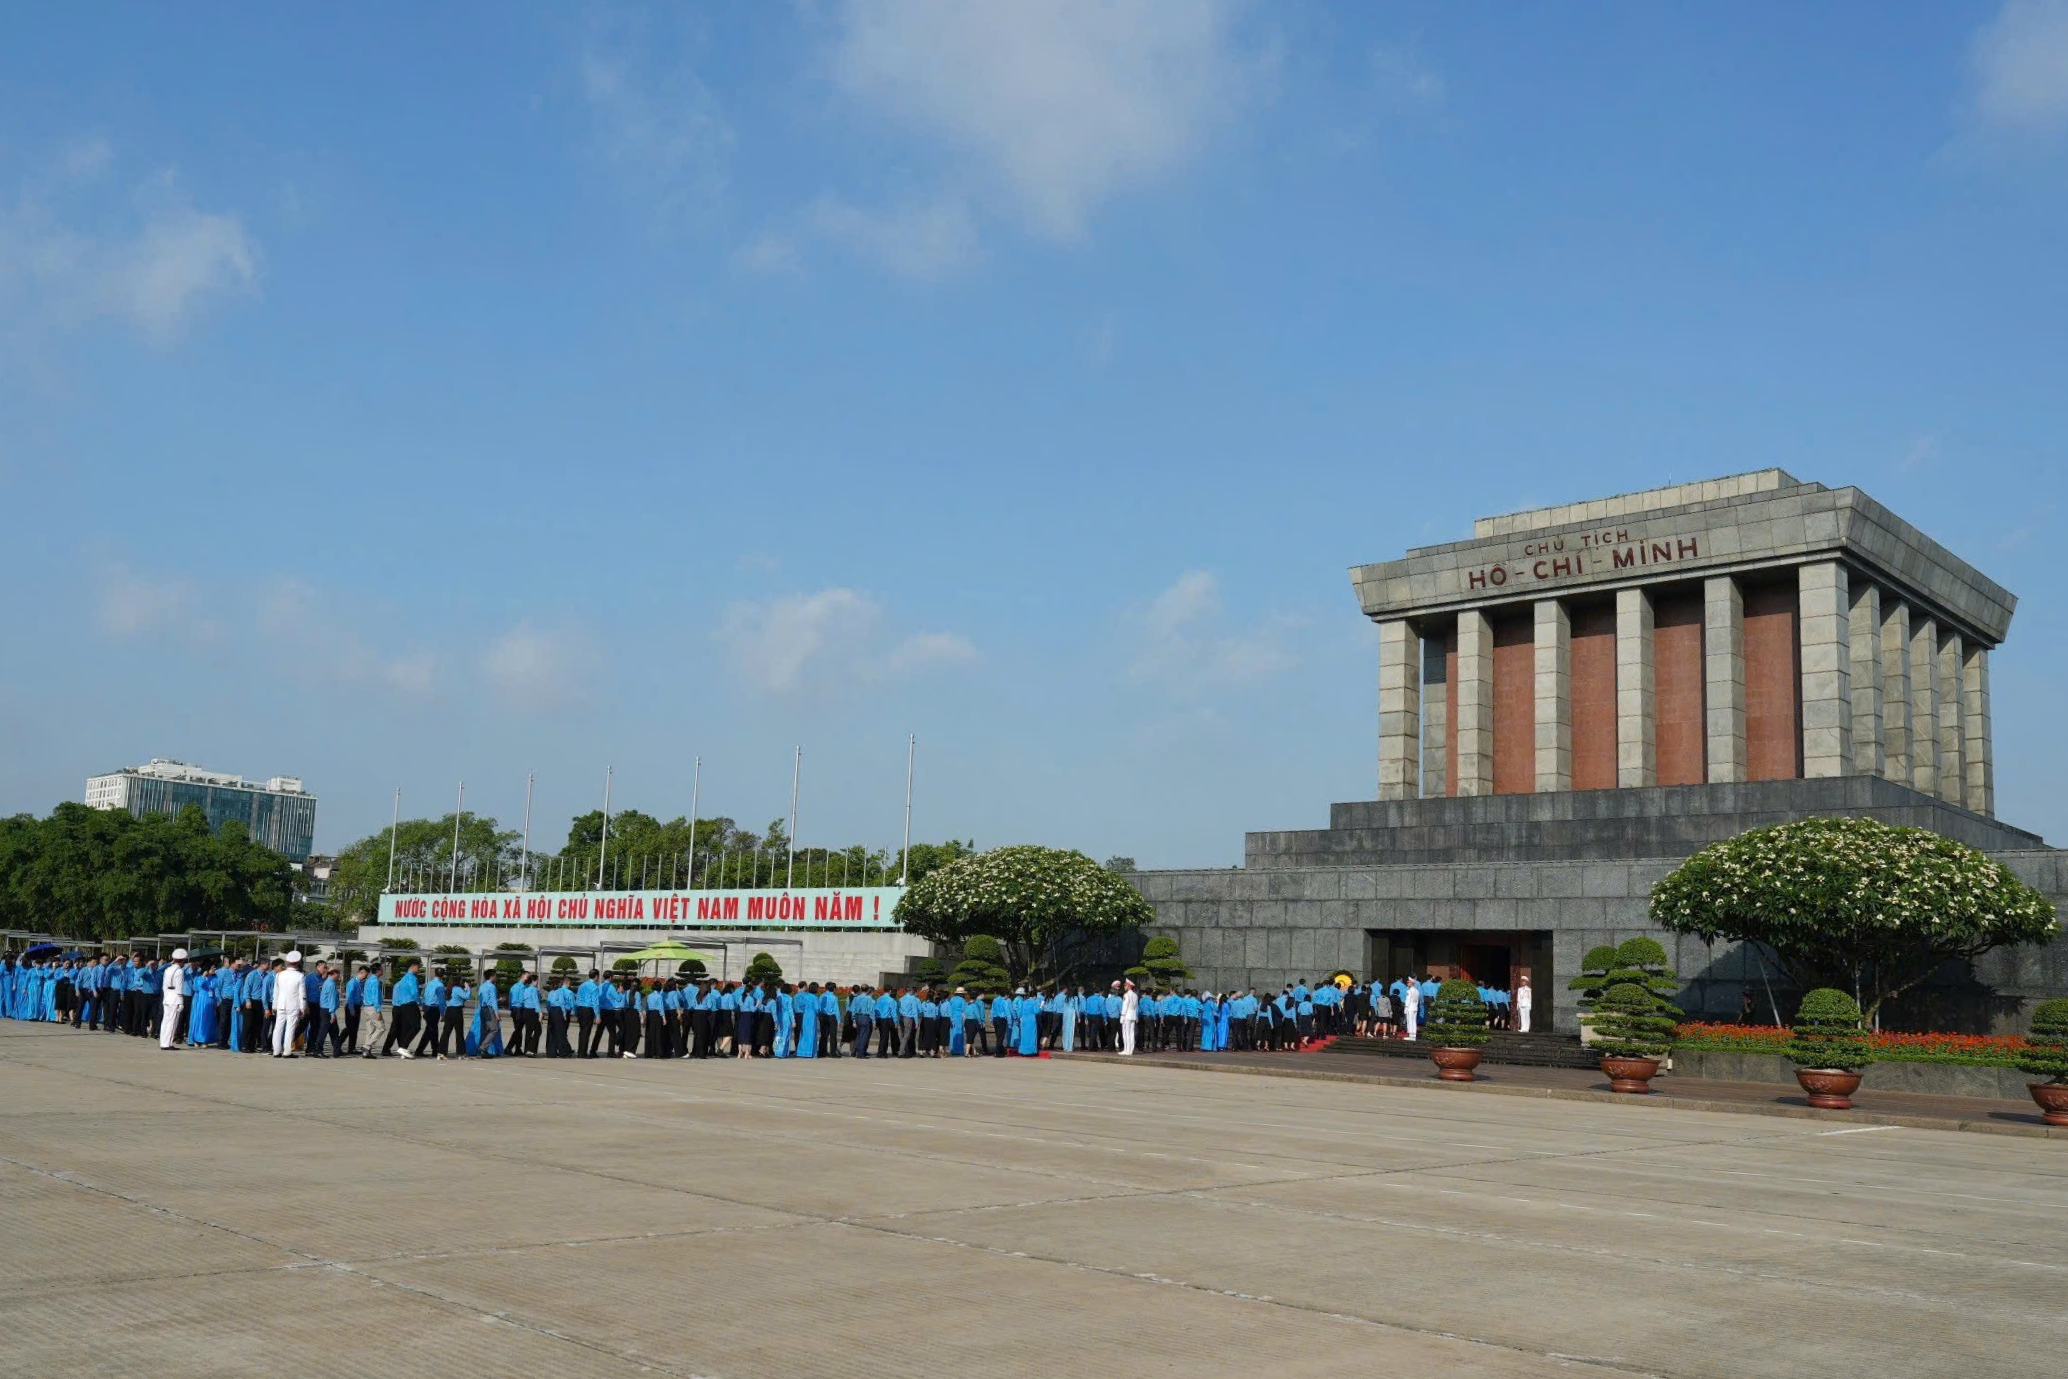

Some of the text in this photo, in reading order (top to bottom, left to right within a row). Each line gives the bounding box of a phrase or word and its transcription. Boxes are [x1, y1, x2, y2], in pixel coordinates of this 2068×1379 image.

[395, 896, 427, 918] NƯỚC
[432, 895, 465, 922] CỘNG
[471, 895, 498, 919] HÒA
[503, 895, 521, 919] XÃ
[527, 894, 552, 923] HỘI
[557, 893, 589, 920] CHỦ
[594, 894, 645, 920] NGHĨA
[652, 893, 690, 923] VIỆT
[697, 896, 740, 920] NAM
[747, 892, 806, 920] MUÔN
[814, 891, 863, 921] NĂM
